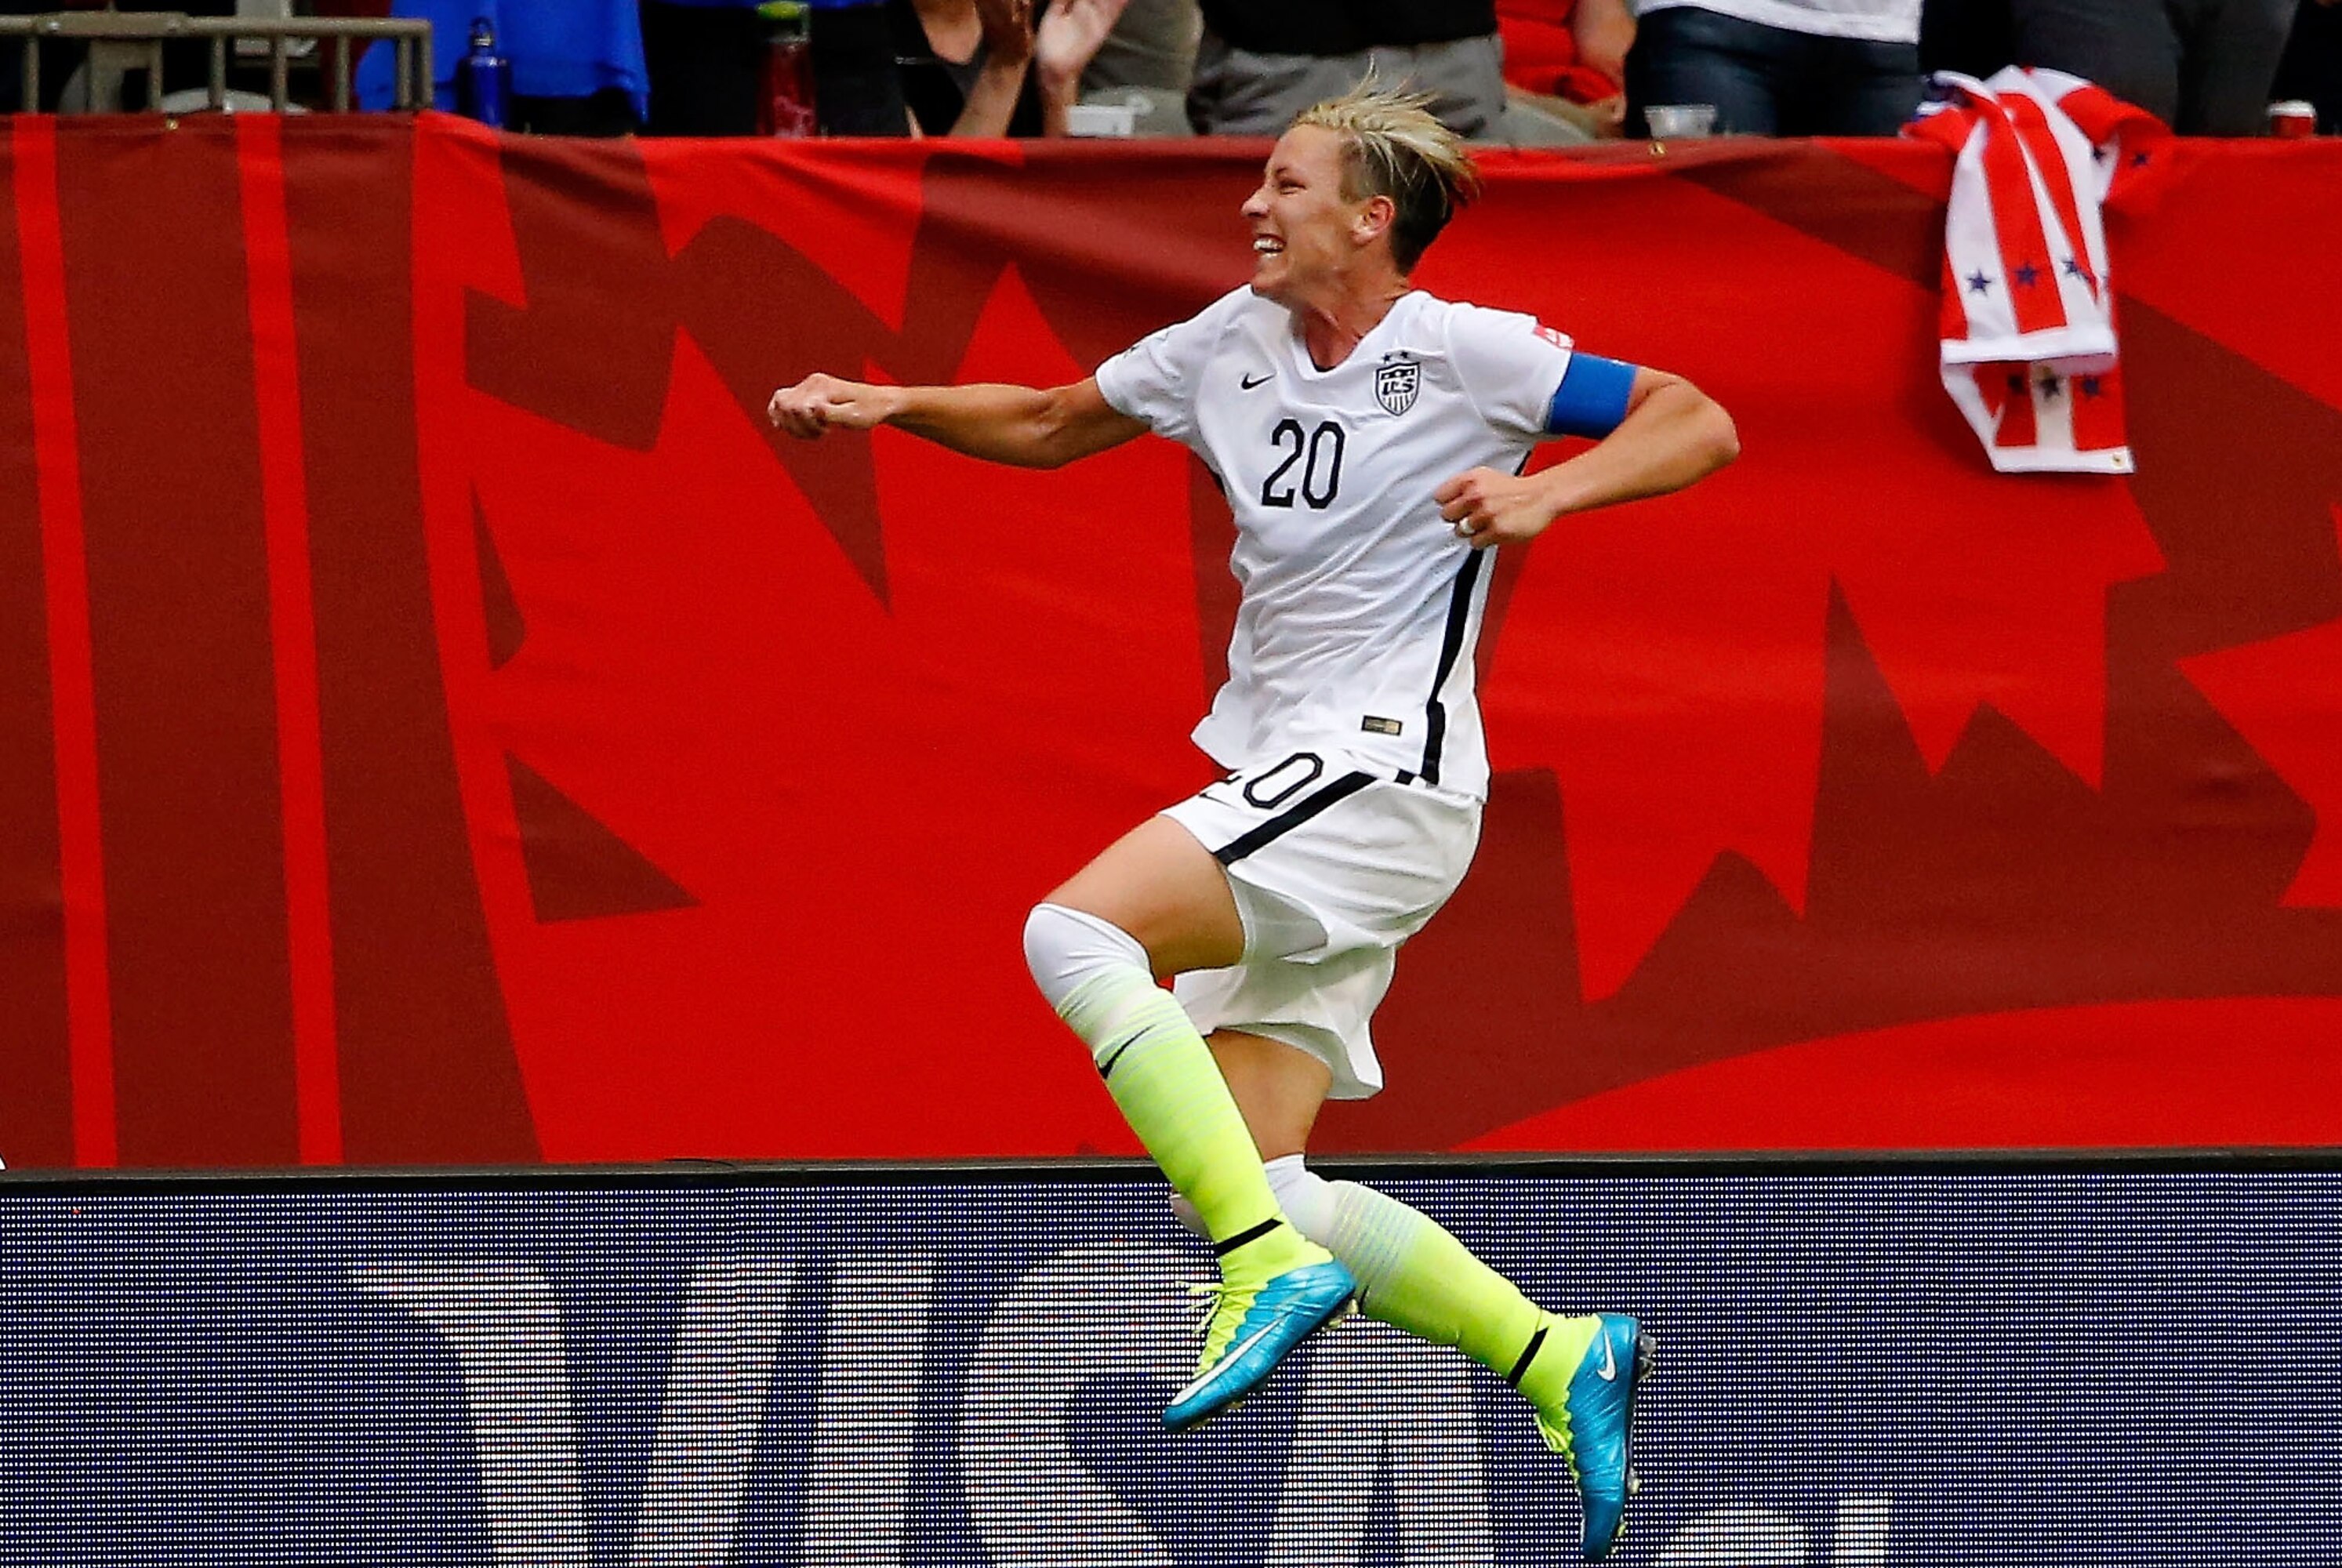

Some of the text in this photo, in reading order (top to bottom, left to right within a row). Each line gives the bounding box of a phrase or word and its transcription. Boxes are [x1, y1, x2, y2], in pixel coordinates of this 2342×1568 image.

[1261, 419, 1345, 509] 20
[1223, 752, 1324, 809] 0
[347, 1248, 1496, 1568] VISA
